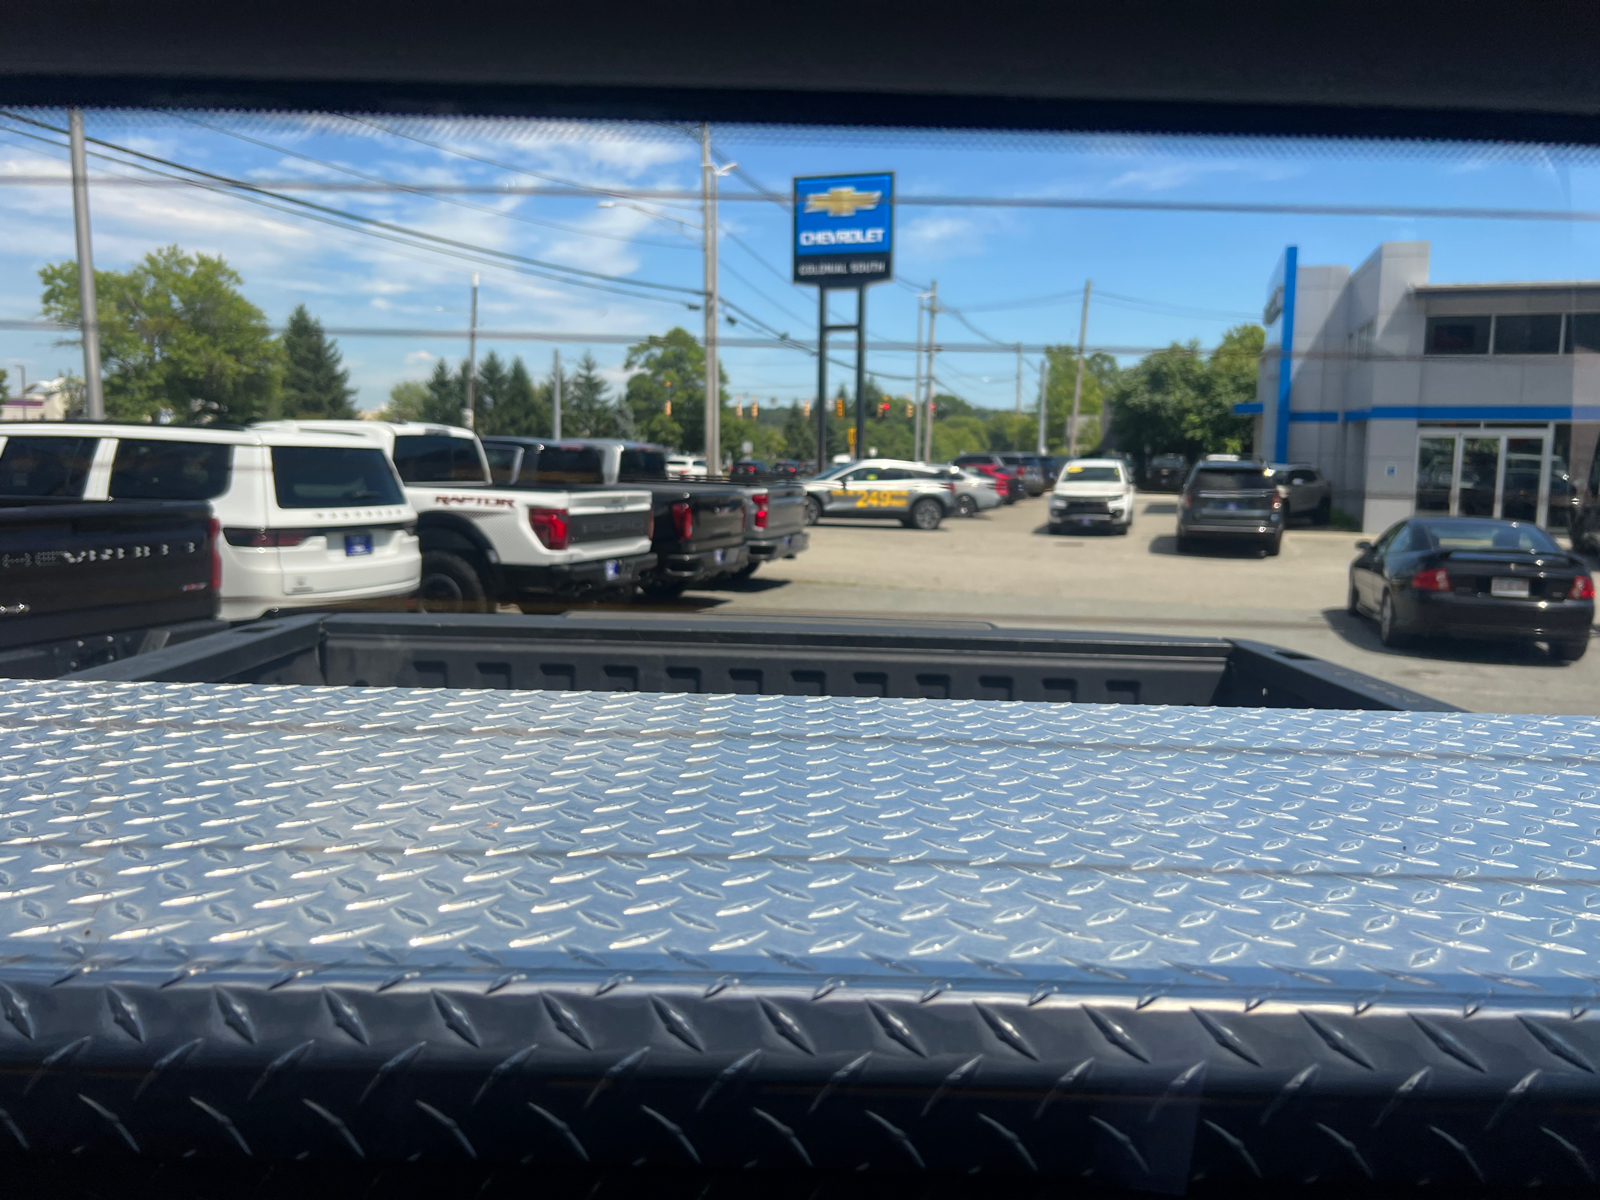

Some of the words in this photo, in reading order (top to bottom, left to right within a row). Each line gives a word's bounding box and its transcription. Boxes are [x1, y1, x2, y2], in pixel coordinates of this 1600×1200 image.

[800, 228, 884, 246] CHEVROLET
[849, 260, 886, 273] SOUTH
[435, 496, 516, 509] RAPTOR
